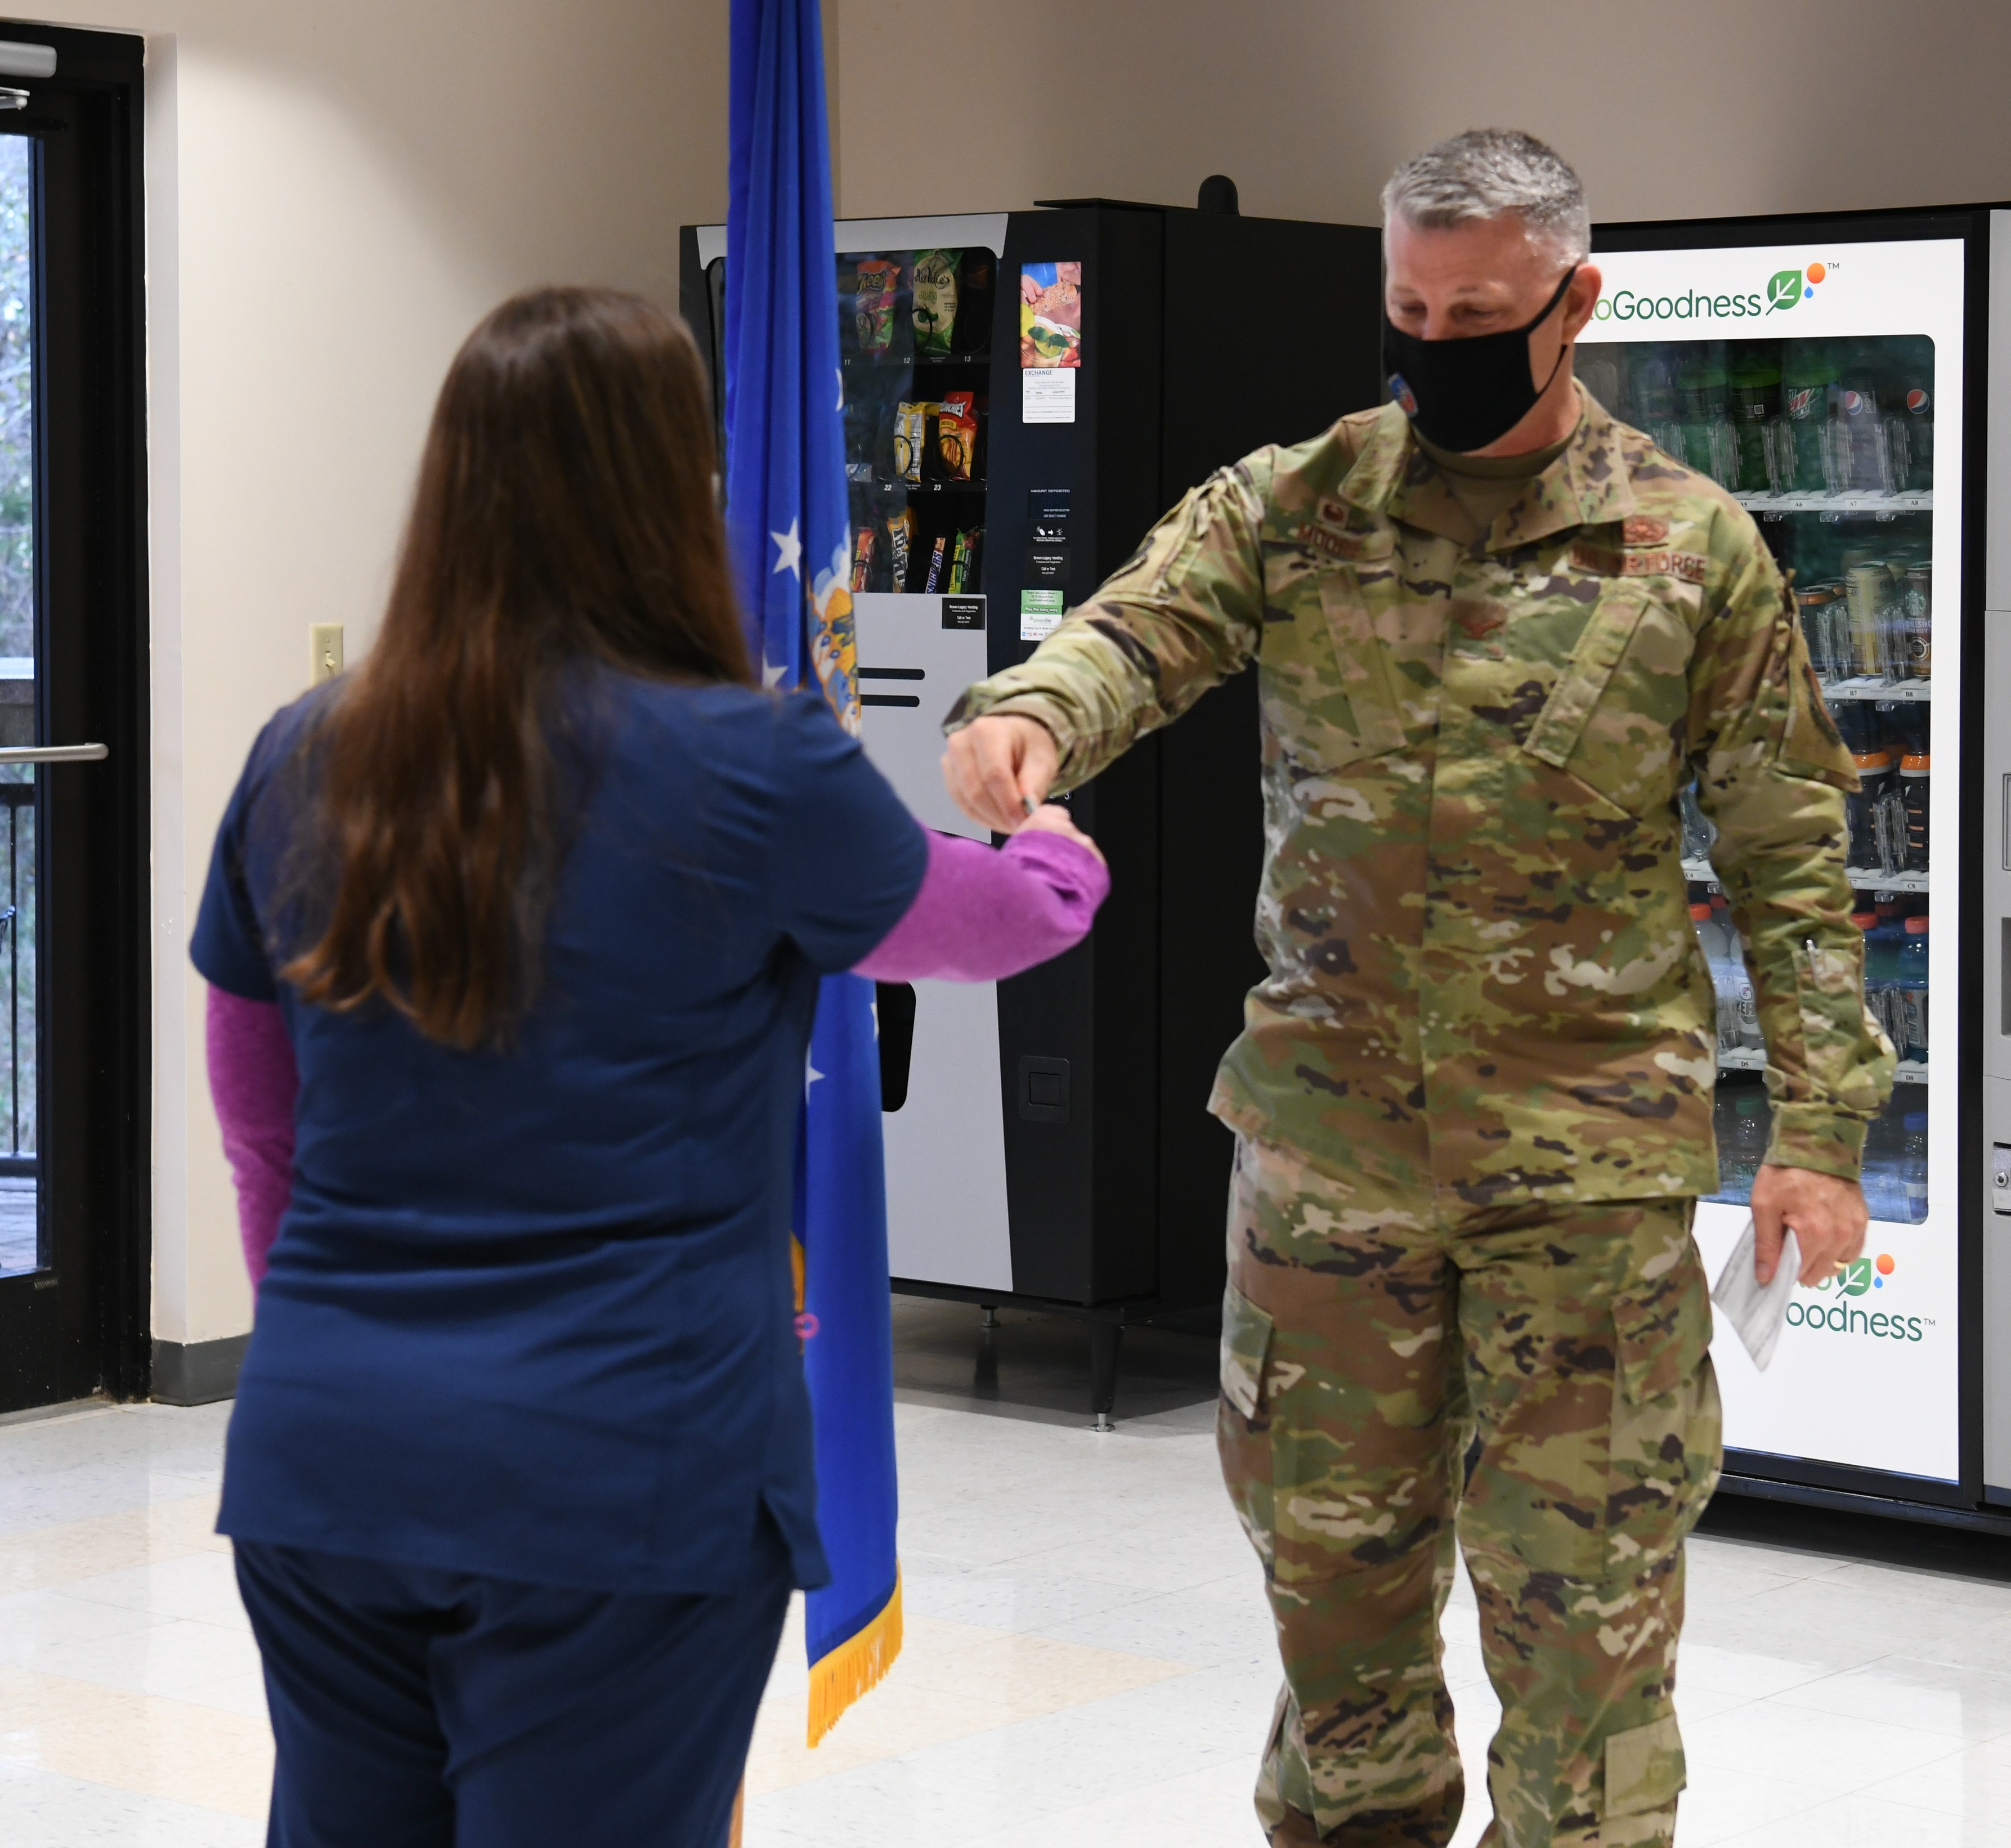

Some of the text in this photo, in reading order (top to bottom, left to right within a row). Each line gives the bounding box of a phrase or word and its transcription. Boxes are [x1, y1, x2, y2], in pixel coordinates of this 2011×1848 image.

[1589, 289, 1762, 321] oGoodness
[1864, 392, 1873, 414] pepsi
[1645, 551, 1707, 581] FORCE
[1786, 1300, 1922, 1342] oodness
